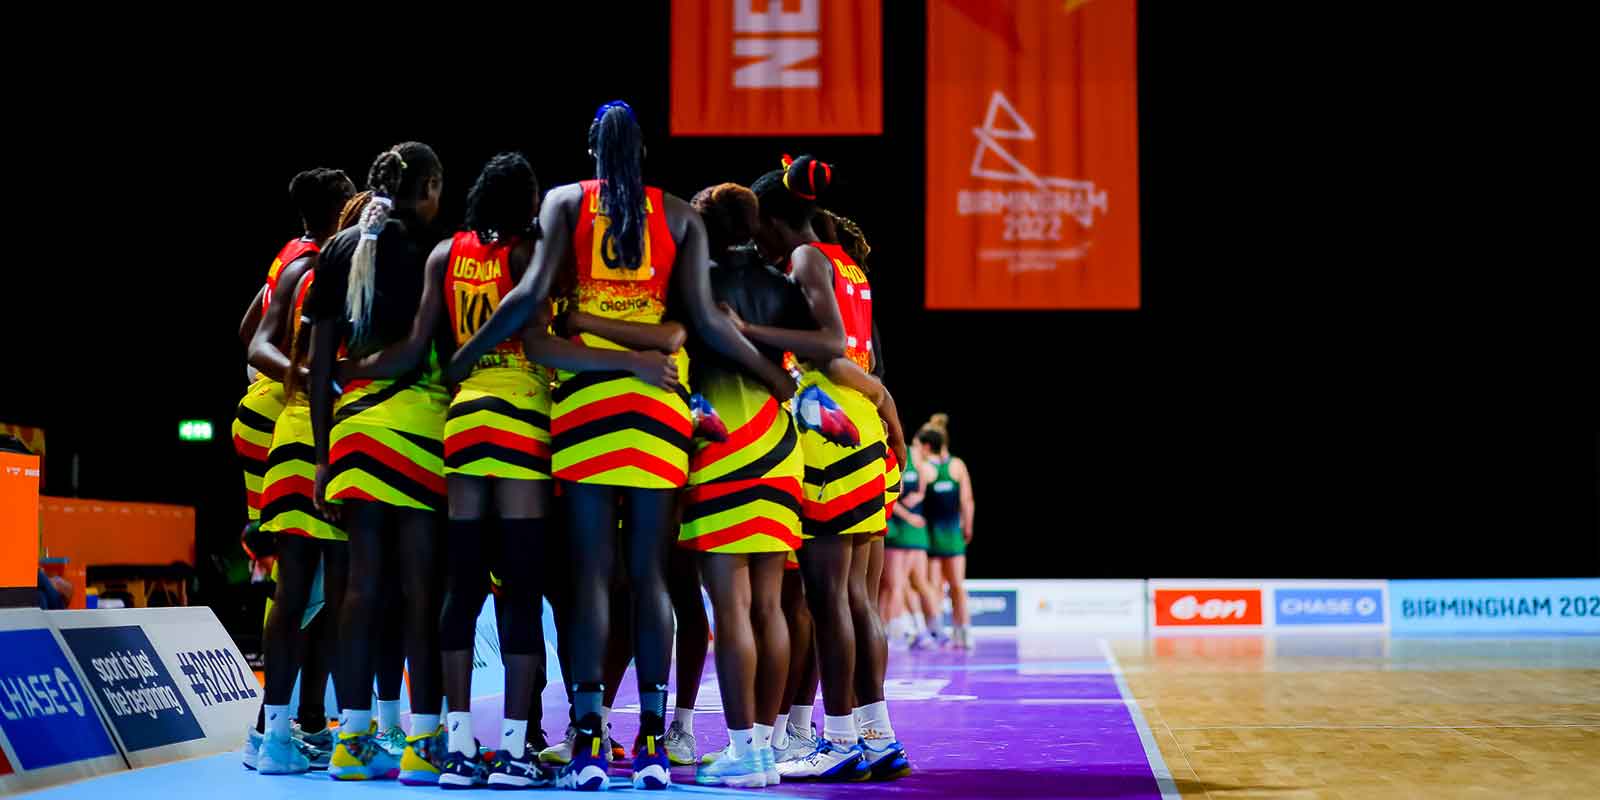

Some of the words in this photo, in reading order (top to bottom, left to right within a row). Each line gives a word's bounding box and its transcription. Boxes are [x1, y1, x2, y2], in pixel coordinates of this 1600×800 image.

[957, 190, 1108, 215] BIRMINGHAM
[1003, 215, 1061, 240] 2022
[1402, 596, 1553, 617] BIRMINGHAM
[1559, 596, 1600, 617] 202
[92, 651, 129, 686] sport
[116, 651, 140, 678] is
[127, 649, 158, 684] just
[176, 647, 258, 707] #B2022
[102, 687, 132, 716] the
[121, 681, 184, 719] beginning
